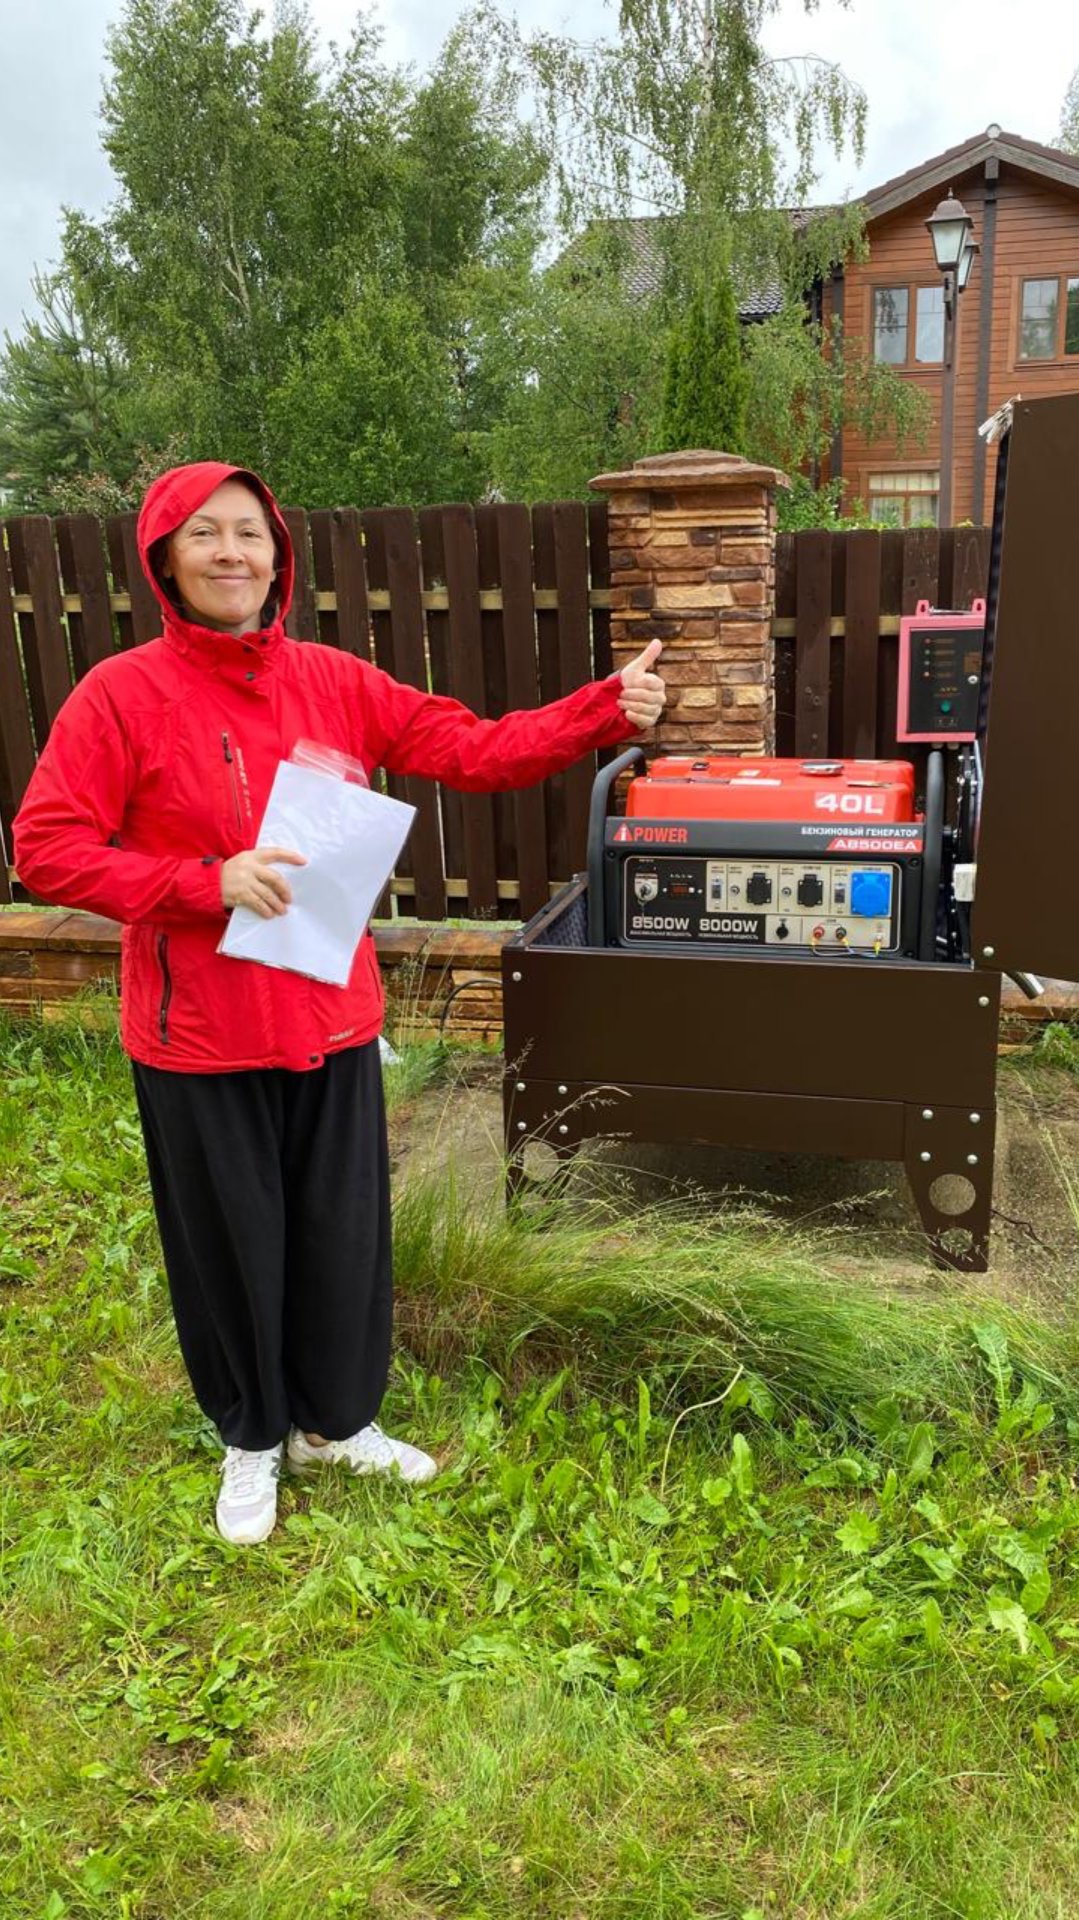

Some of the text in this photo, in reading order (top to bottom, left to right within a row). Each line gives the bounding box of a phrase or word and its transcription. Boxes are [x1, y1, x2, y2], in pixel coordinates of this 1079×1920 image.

[815, 793, 885, 815] 40L
[801, 826, 919, 838] БЕНЗИНОВЫЙ ГЕНЕРАТОР
[633, 916, 689, 930] 8500W
[699, 918, 758, 932] 8000W
